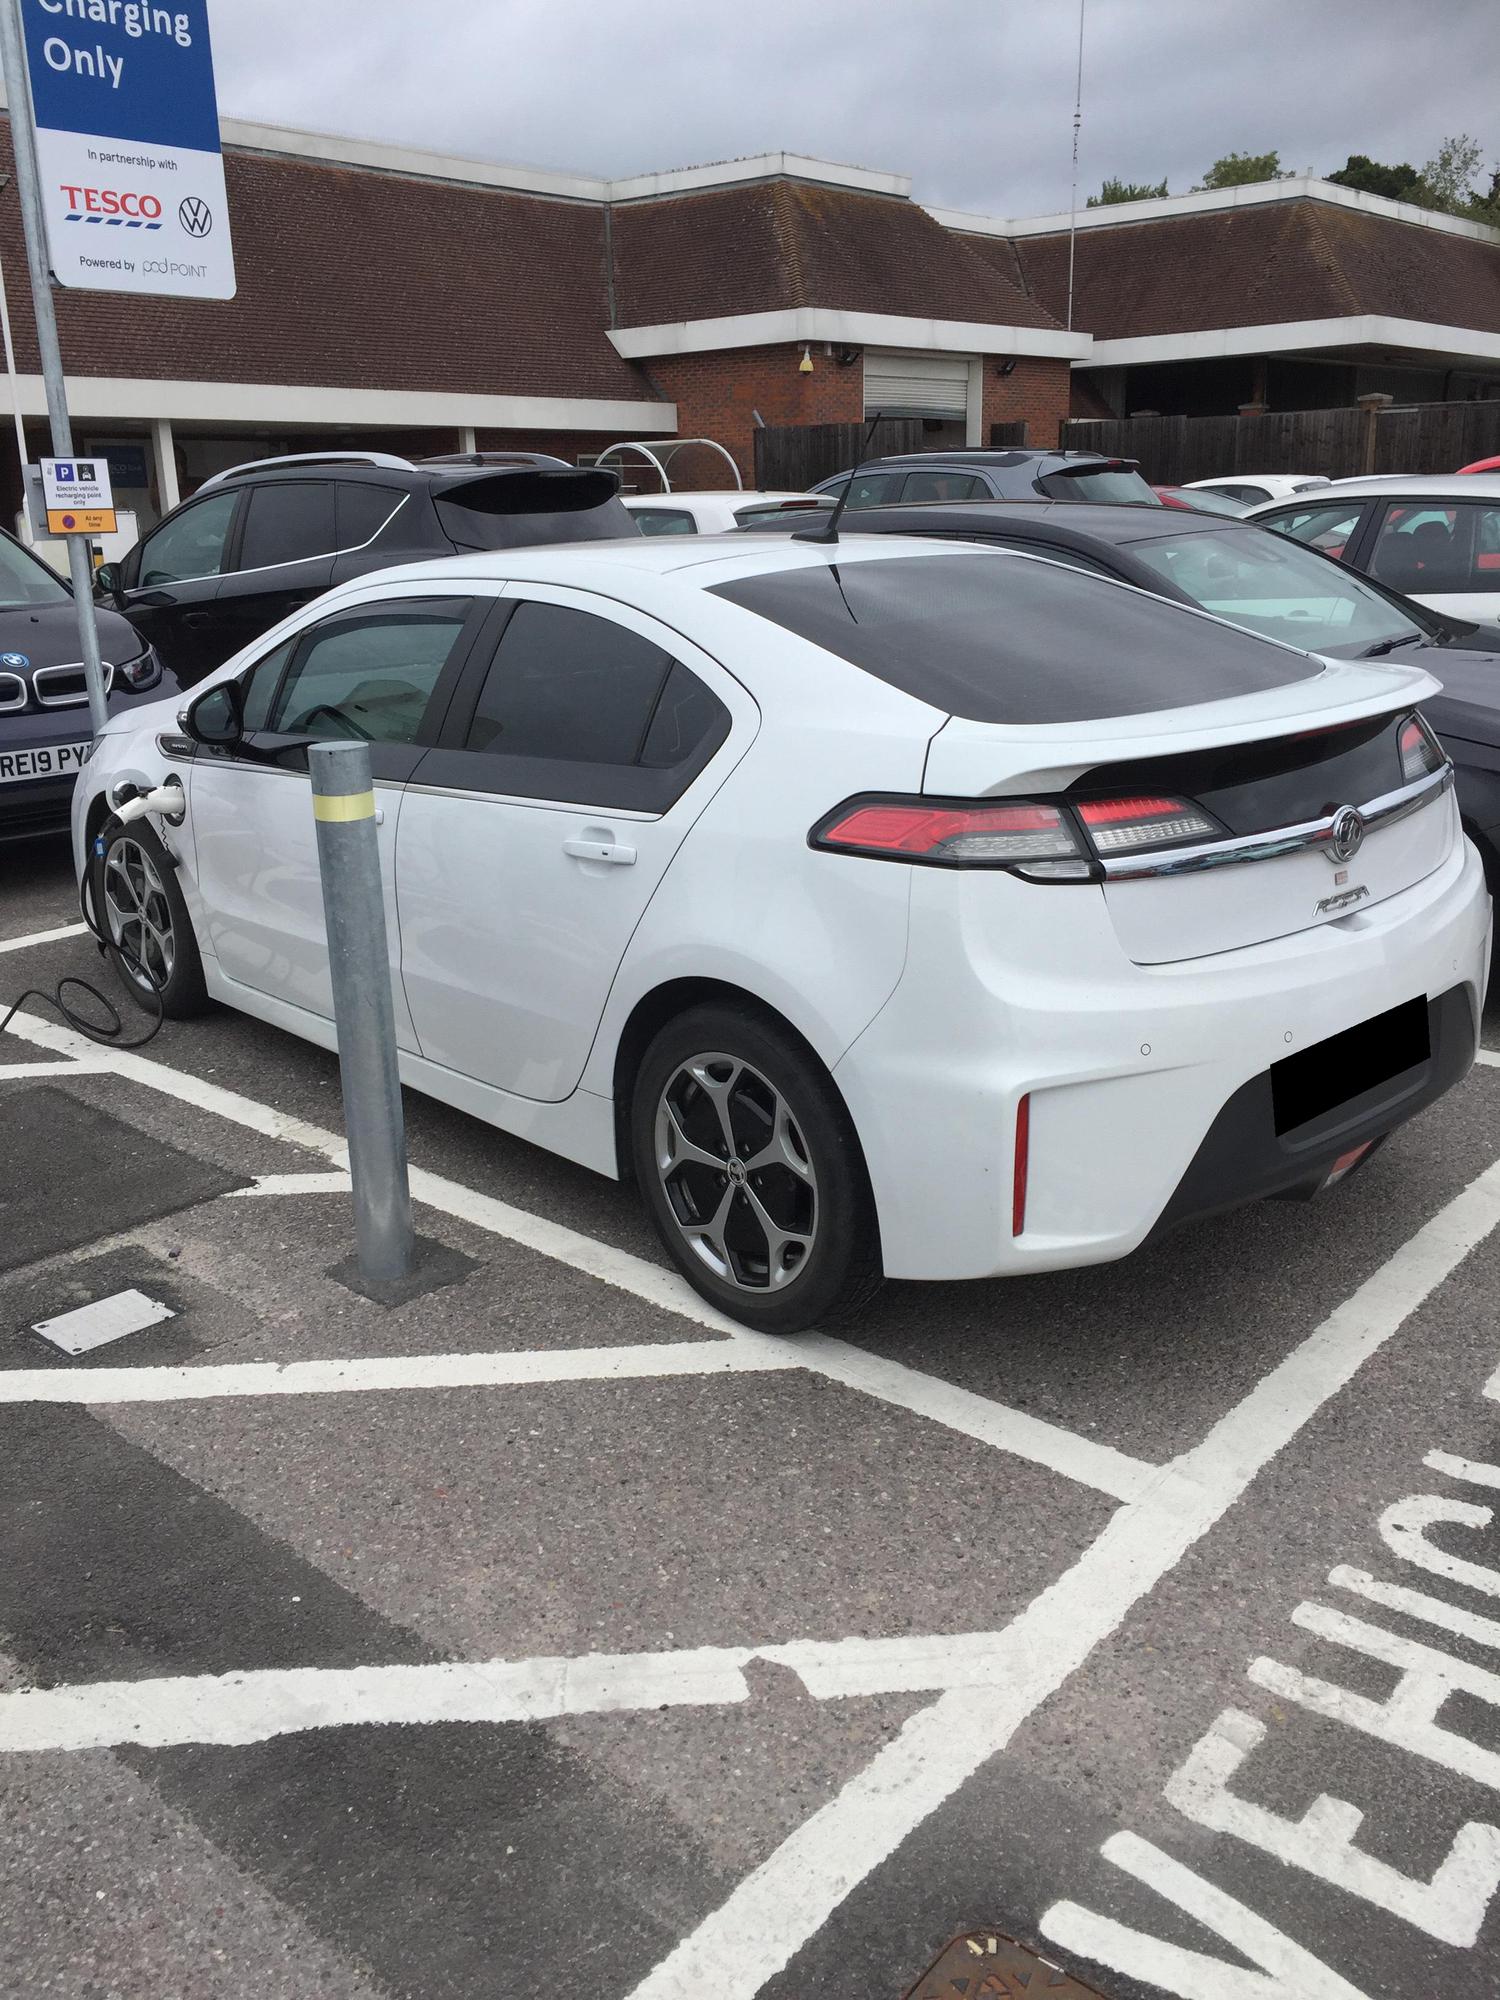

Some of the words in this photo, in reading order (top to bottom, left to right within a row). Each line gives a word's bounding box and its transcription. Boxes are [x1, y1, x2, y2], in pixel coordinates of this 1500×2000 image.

[43, 37, 124, 89] Only
[87, 149, 97, 160] In
[99, 152, 156, 169] partnership
[158, 158, 178, 171] with
[60, 185, 162, 219] TESCO
[79, 255, 122, 270] Powered
[124, 259, 135, 273] by
[0, 750, 52, 777] RE19
[57, 745, 92, 770] PY
